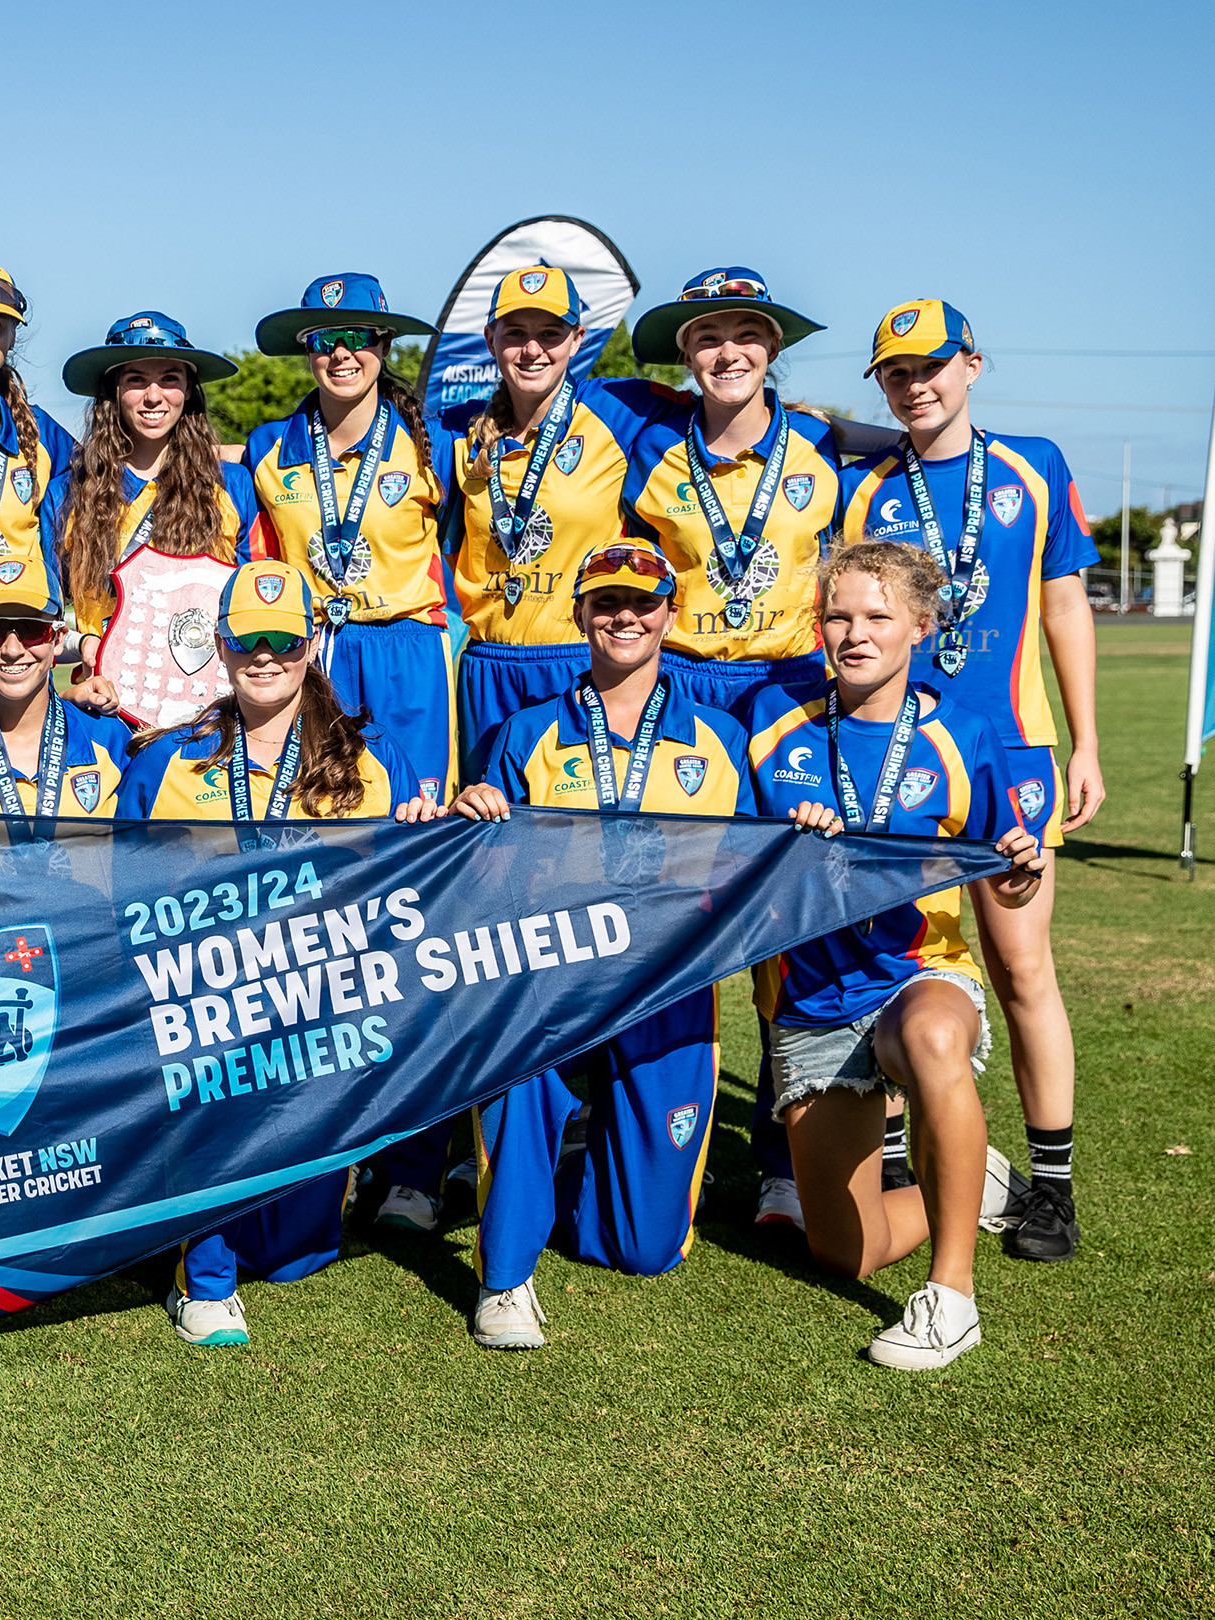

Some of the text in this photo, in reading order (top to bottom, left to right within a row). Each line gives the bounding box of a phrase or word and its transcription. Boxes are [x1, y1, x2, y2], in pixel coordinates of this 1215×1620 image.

[313, 409, 336, 527] NSW PREMIER CRICKET
[347, 405, 389, 523] NSW PREMIER CRICKET
[521, 469, 538, 500] NSW
[531, 422, 558, 472] PREMIER
[549, 381, 574, 423] CRICKET
[687, 435, 725, 527] PREMIER CRICKET
[752, 492, 769, 520] NSW
[765, 447, 784, 493] PREMIER
[135, 519, 153, 544] NSW
[905, 448, 947, 568] NSW PREMIER CRICKET
[960, 438, 984, 563] NSW PREMIER CRICKET
[46, 736, 63, 787] PREMIER
[582, 686, 615, 805] NSW PREMIER CRICKET
[626, 683, 666, 799] NSW PREMIER CRICKET
[774, 769, 822, 784] COASTFIN
[829, 690, 837, 715] NSW
[840, 774, 860, 823] CRICKET
[873, 696, 916, 824] NSW PREMIER CRICKET
[41, 788, 57, 817] NSW
[234, 778, 249, 821] CRICKET
[125, 861, 323, 945] 2023/24
[134, 887, 425, 1002] WOMEN'S
[149, 902, 631, 1056] BREWER SHIELD
[162, 1015, 393, 1111] PREMIERS
[24, 1165, 102, 1199] CRICKET
[38, 1137, 98, 1172] NSW
